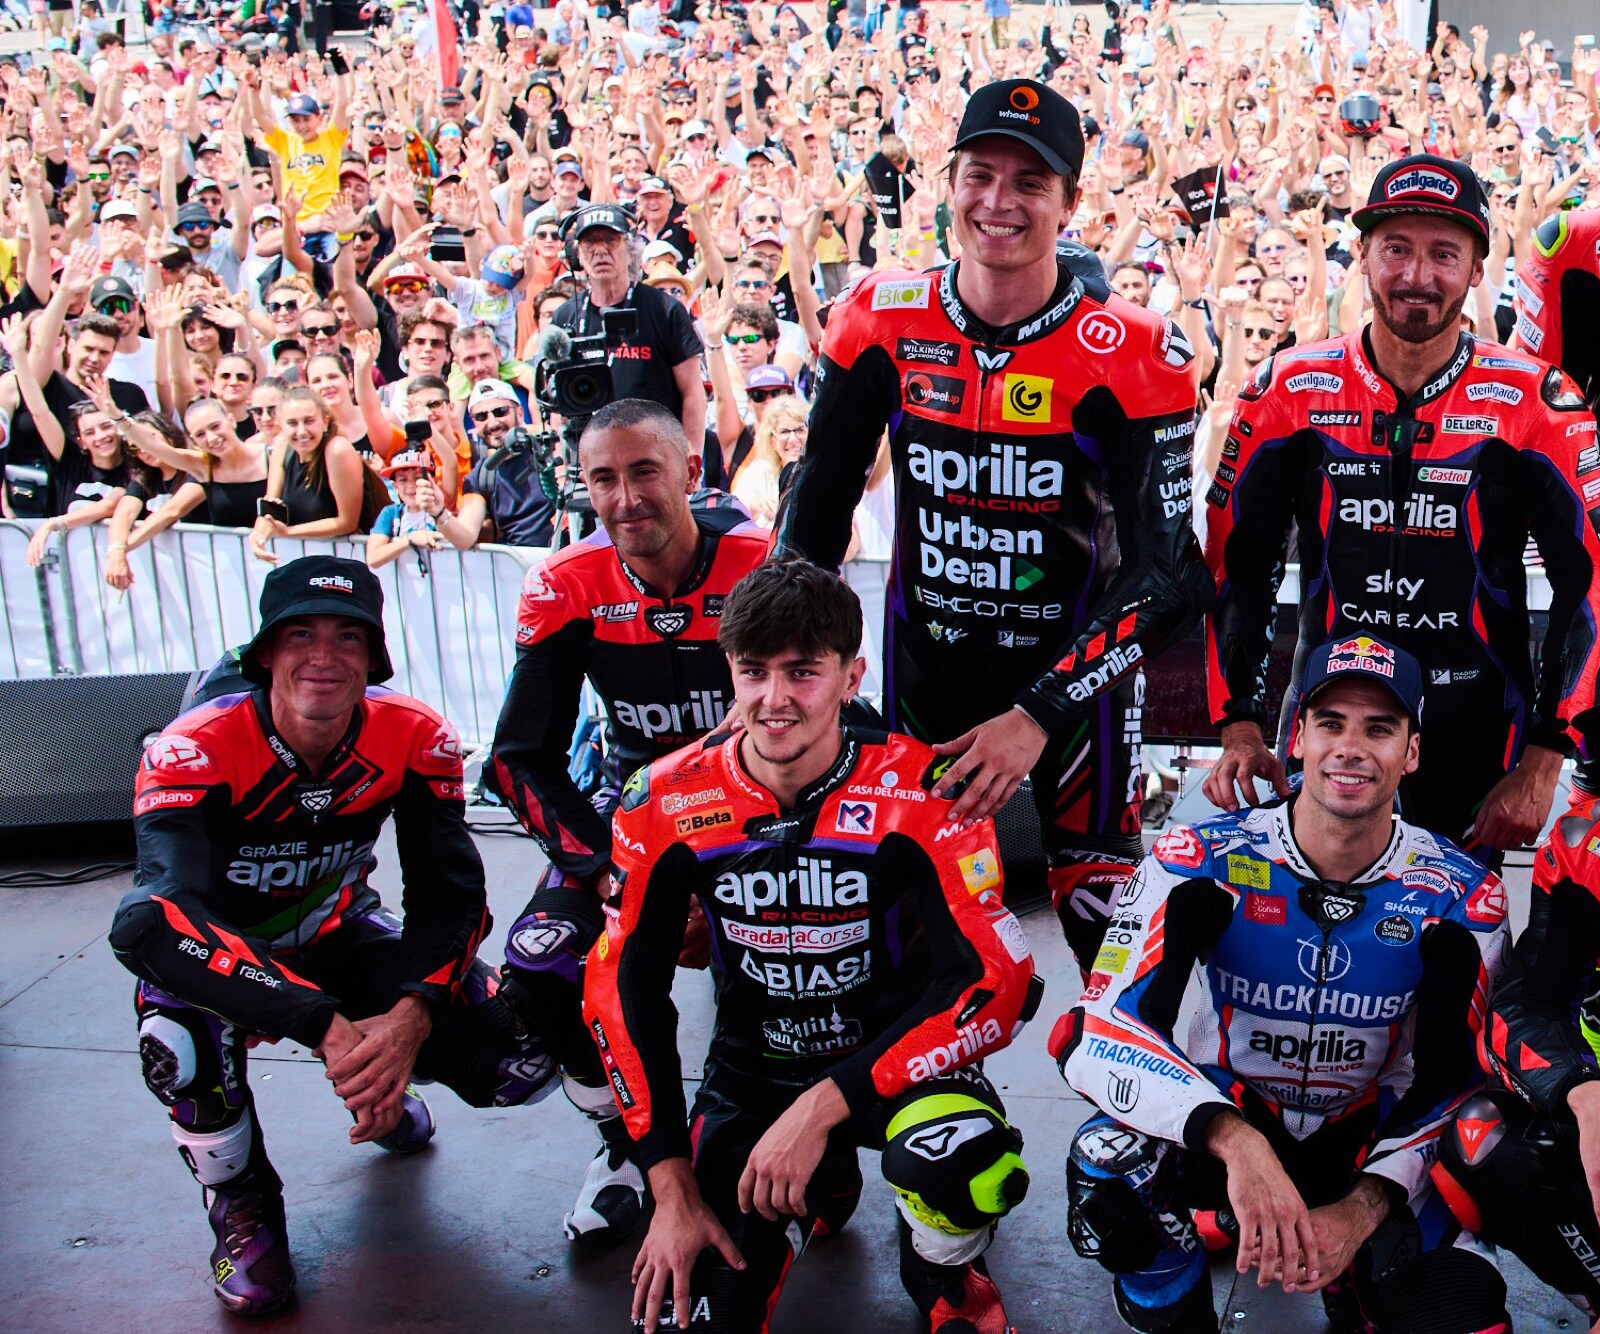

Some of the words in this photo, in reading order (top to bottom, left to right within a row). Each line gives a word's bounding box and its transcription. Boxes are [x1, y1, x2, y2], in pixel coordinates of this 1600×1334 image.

[999, 110, 1041, 125] wheelup
[1389, 171, 1455, 196] sterilgarda
[1018, 287, 1081, 342] MTECH
[903, 344, 954, 358] WILKINSON
[1288, 373, 1340, 389] sterilgarda
[1353, 353, 1382, 394] aprilia
[1423, 348, 1471, 401] DAINESE
[919, 388, 961, 405] wheelup
[1469, 383, 1520, 402] sterilgarda
[1310, 414, 1346, 425] CASE
[1154, 420, 1196, 443] MAURER
[908, 442, 1064, 498] aprilia
[1328, 462, 1366, 477] CAME
[1429, 468, 1471, 484] Castrol
[1159, 476, 1193, 501] Urba
[947, 493, 1062, 513] RACING
[1339, 492, 1457, 531] aprilia
[918, 507, 1043, 554] Urban
[1372, 524, 1456, 538] RACING
[920, 542, 1012, 591] Deal
[309, 576, 353, 590] aprilia
[622, 562, 646, 595] aprilia
[1366, 570, 1425, 600] sky
[591, 601, 640, 623] NOLAN
[1066, 642, 1144, 703] aprilia
[1327, 656, 1358, 674] Red
[1359, 657, 1395, 677] Bull
[613, 689, 738, 739] aprili
[268, 735, 298, 769] aprilia
[807, 740, 857, 802] MACNA
[848, 785, 876, 796] CASA
[877, 786, 897, 798] DEL
[898, 789, 926, 803] FILTRO
[691, 811, 732, 830] Beta
[759, 819, 800, 834] MACNA
[239, 841, 308, 858] GRAZIE
[1275, 816, 1307, 871] IXON
[1089, 875, 1132, 884] MTECH
[1427, 859, 1473, 879] MICHELIN
[714, 855, 869, 918] aprilia
[1404, 872, 1446, 890] sterilgarda
[761, 910, 869, 921] RACING
[1384, 901, 1428, 916] SHARK
[727, 921, 866, 944] GradaraCorse
[1381, 929, 1407, 940] Galicia
[1383, 920, 1410, 933] Estrella
[179, 938, 210, 960] #be
[217, 955, 231, 969] a
[239, 964, 282, 989] racer
[766, 950, 871, 992] BIASI
[817, 987, 844, 999] MADE
[844, 984, 853, 994] IN
[853, 971, 872, 990] ITALY
[1216, 968, 1415, 1021] TRACKHOUSE
[763, 1027, 792, 1048] San
[1249, 1030, 1367, 1064] aprilia
[906, 1017, 1003, 1084] aprilia
[1086, 1037, 1196, 1087] TRACKHOUSE
[1281, 1060, 1365, 1073] RACING
[611, 1071, 631, 1106] racer
